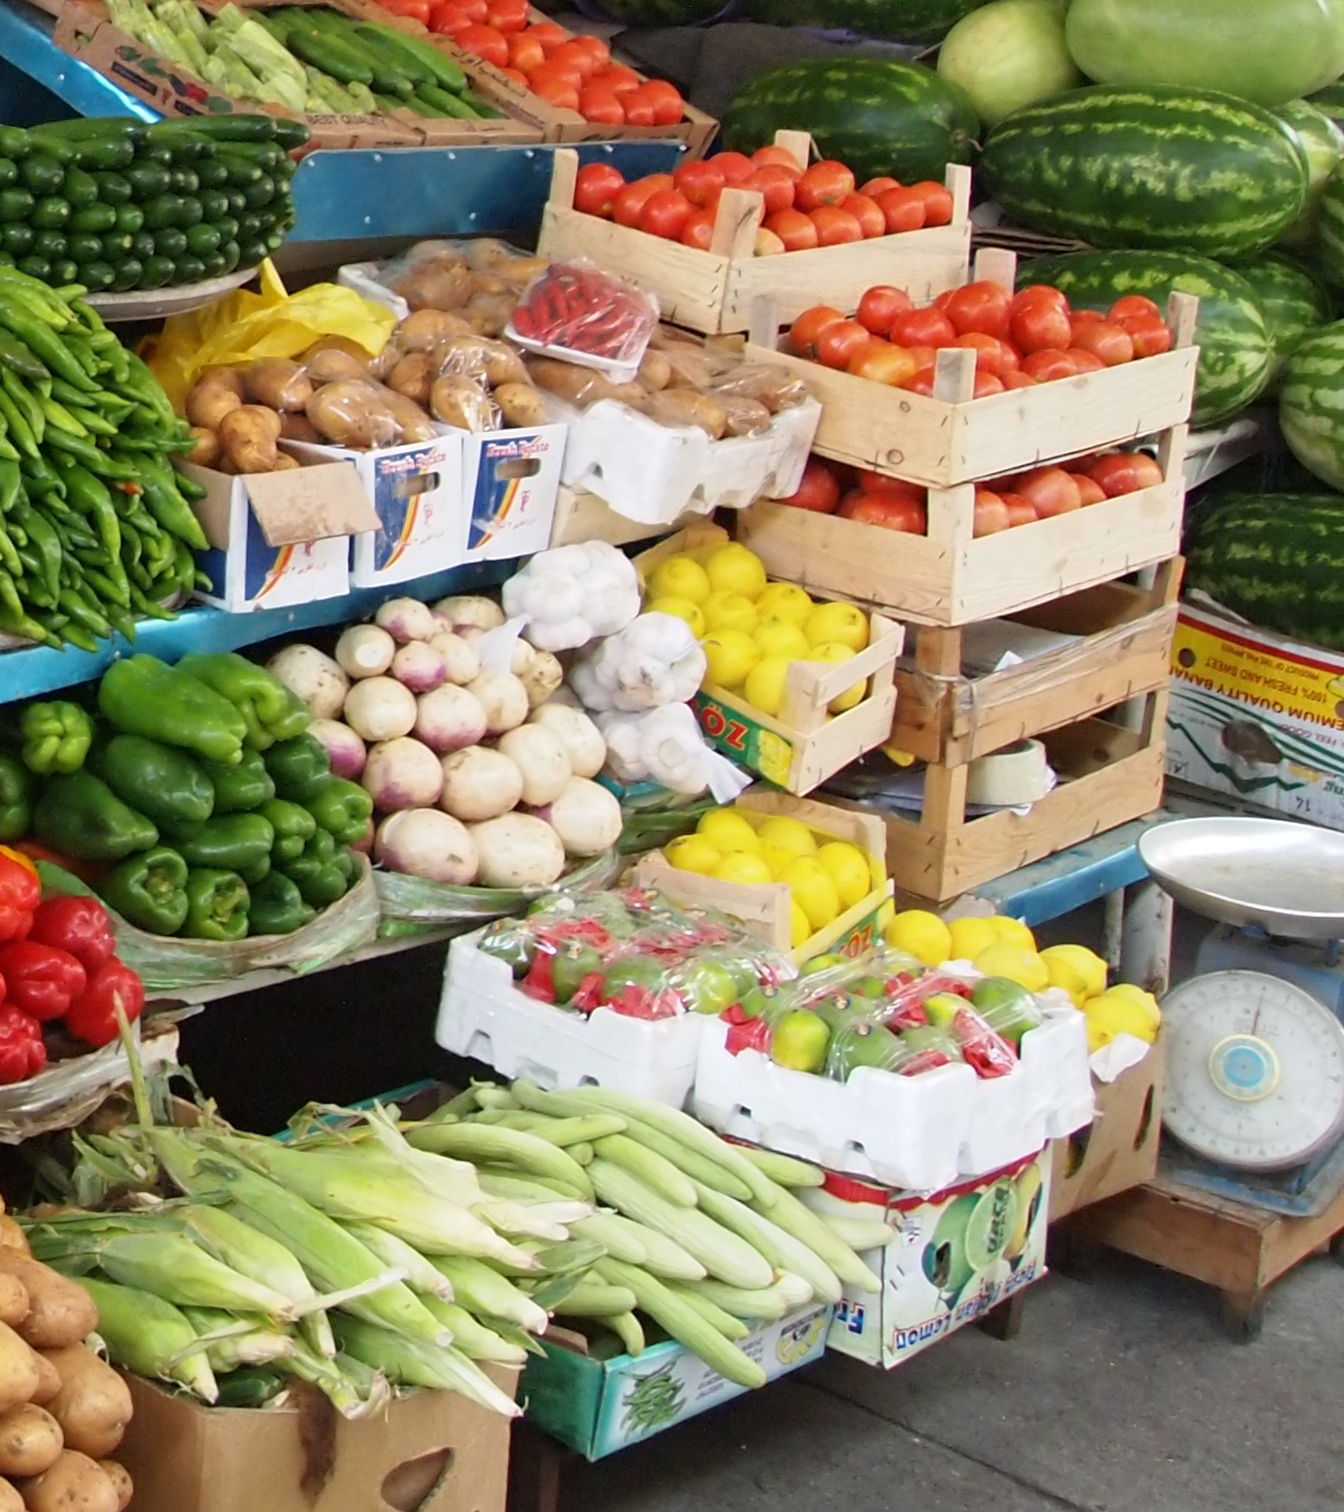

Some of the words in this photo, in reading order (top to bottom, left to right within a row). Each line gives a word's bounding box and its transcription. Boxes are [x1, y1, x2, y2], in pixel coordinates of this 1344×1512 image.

[1204, 656, 1238, 679] SWEET
[1239, 669, 1260, 685] AND
[1261, 675, 1299, 697] FRESH
[1300, 686, 1328, 704] 100%
[1216, 683, 1284, 714] QUALITY
[688, 699, 750, 751] ÖZ
[895, 1315, 951, 1350] Lemon
